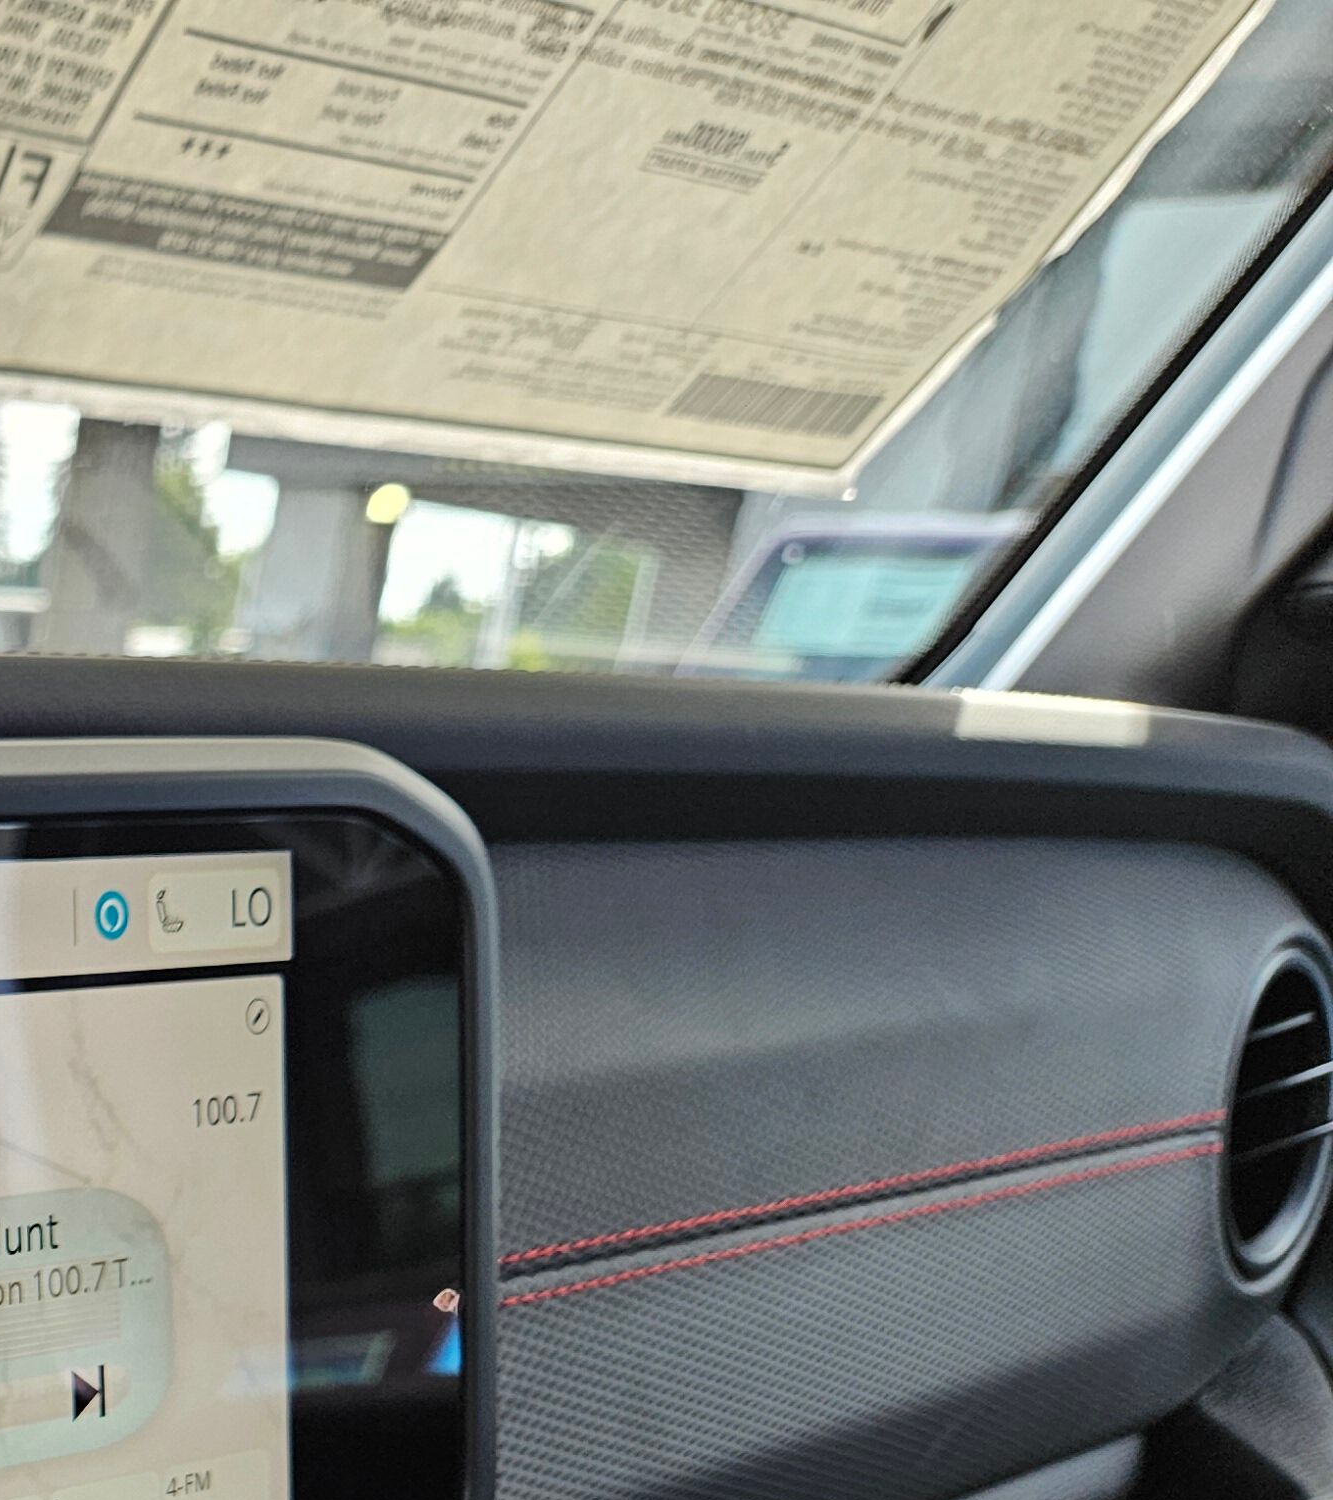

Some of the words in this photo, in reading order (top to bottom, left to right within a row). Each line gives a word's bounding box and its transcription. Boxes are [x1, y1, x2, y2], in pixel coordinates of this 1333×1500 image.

[230, 888, 273, 927] LO
[192, 1093, 263, 1128] 100.7
[34, 1262, 106, 1301] 100.7
[166, 1471, 212, 1497] 4-FM
